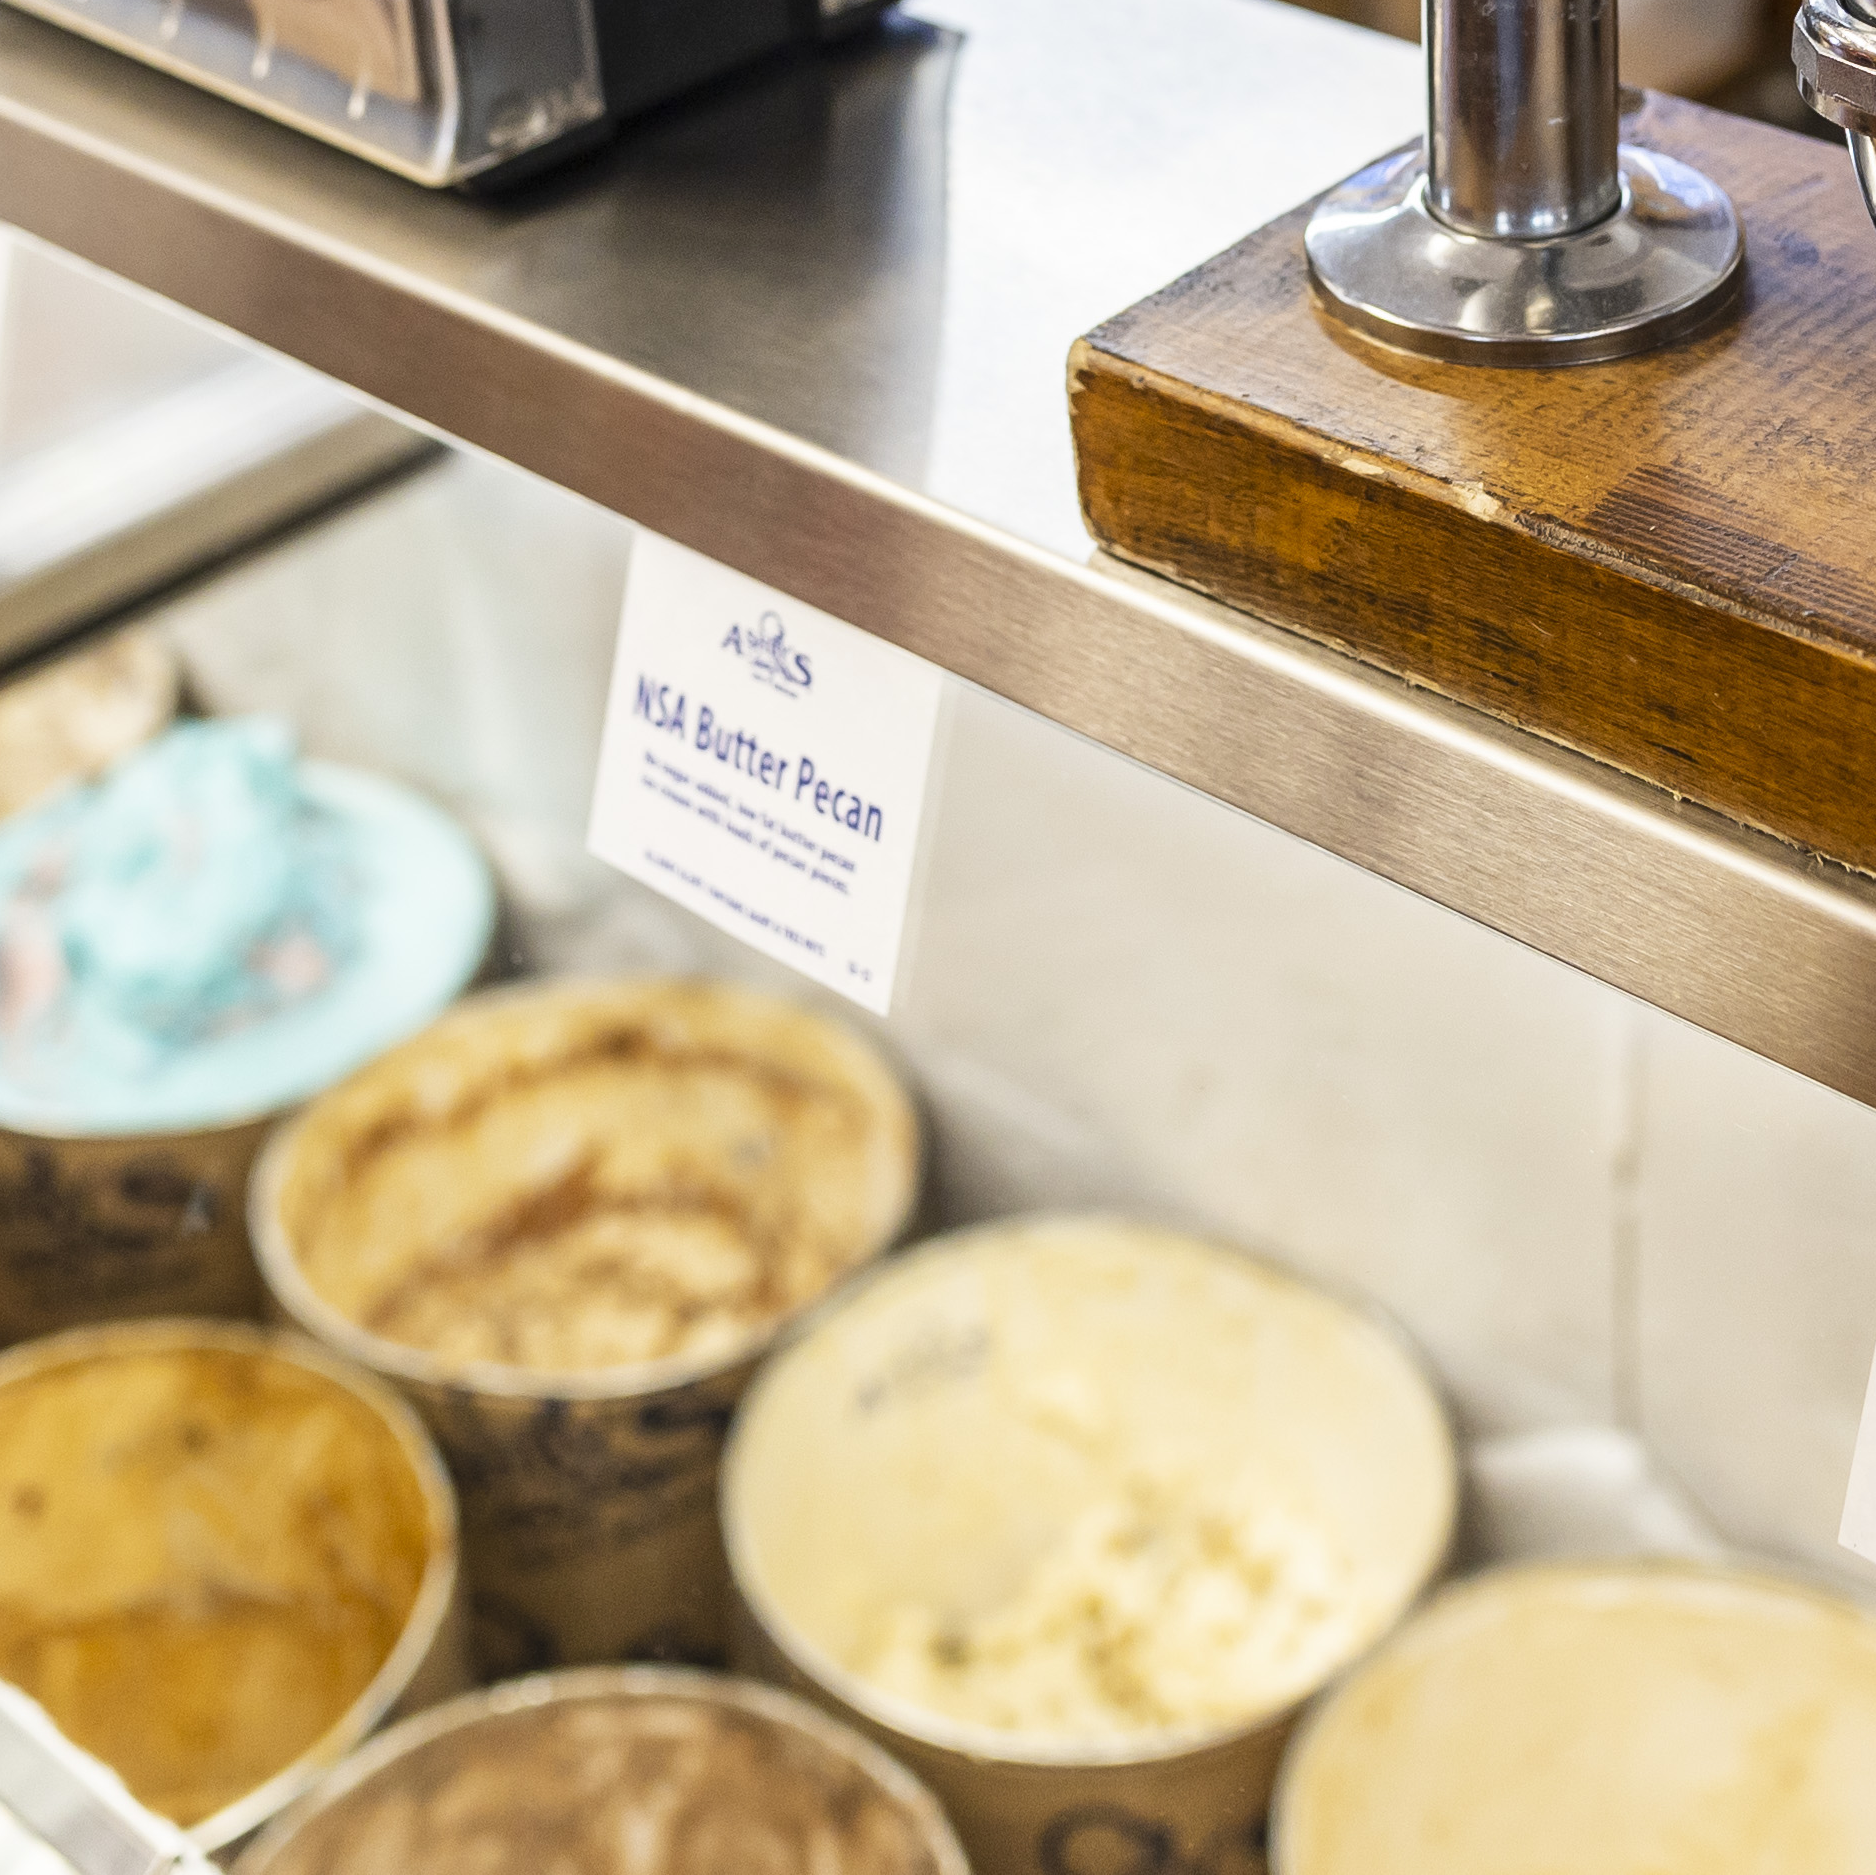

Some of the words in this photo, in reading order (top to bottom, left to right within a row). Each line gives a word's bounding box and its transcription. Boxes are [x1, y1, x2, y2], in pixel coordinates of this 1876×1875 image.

[633, 673, 685, 740] NSA
[695, 705, 788, 791] Butter
[795, 756, 883, 842] Pecan
